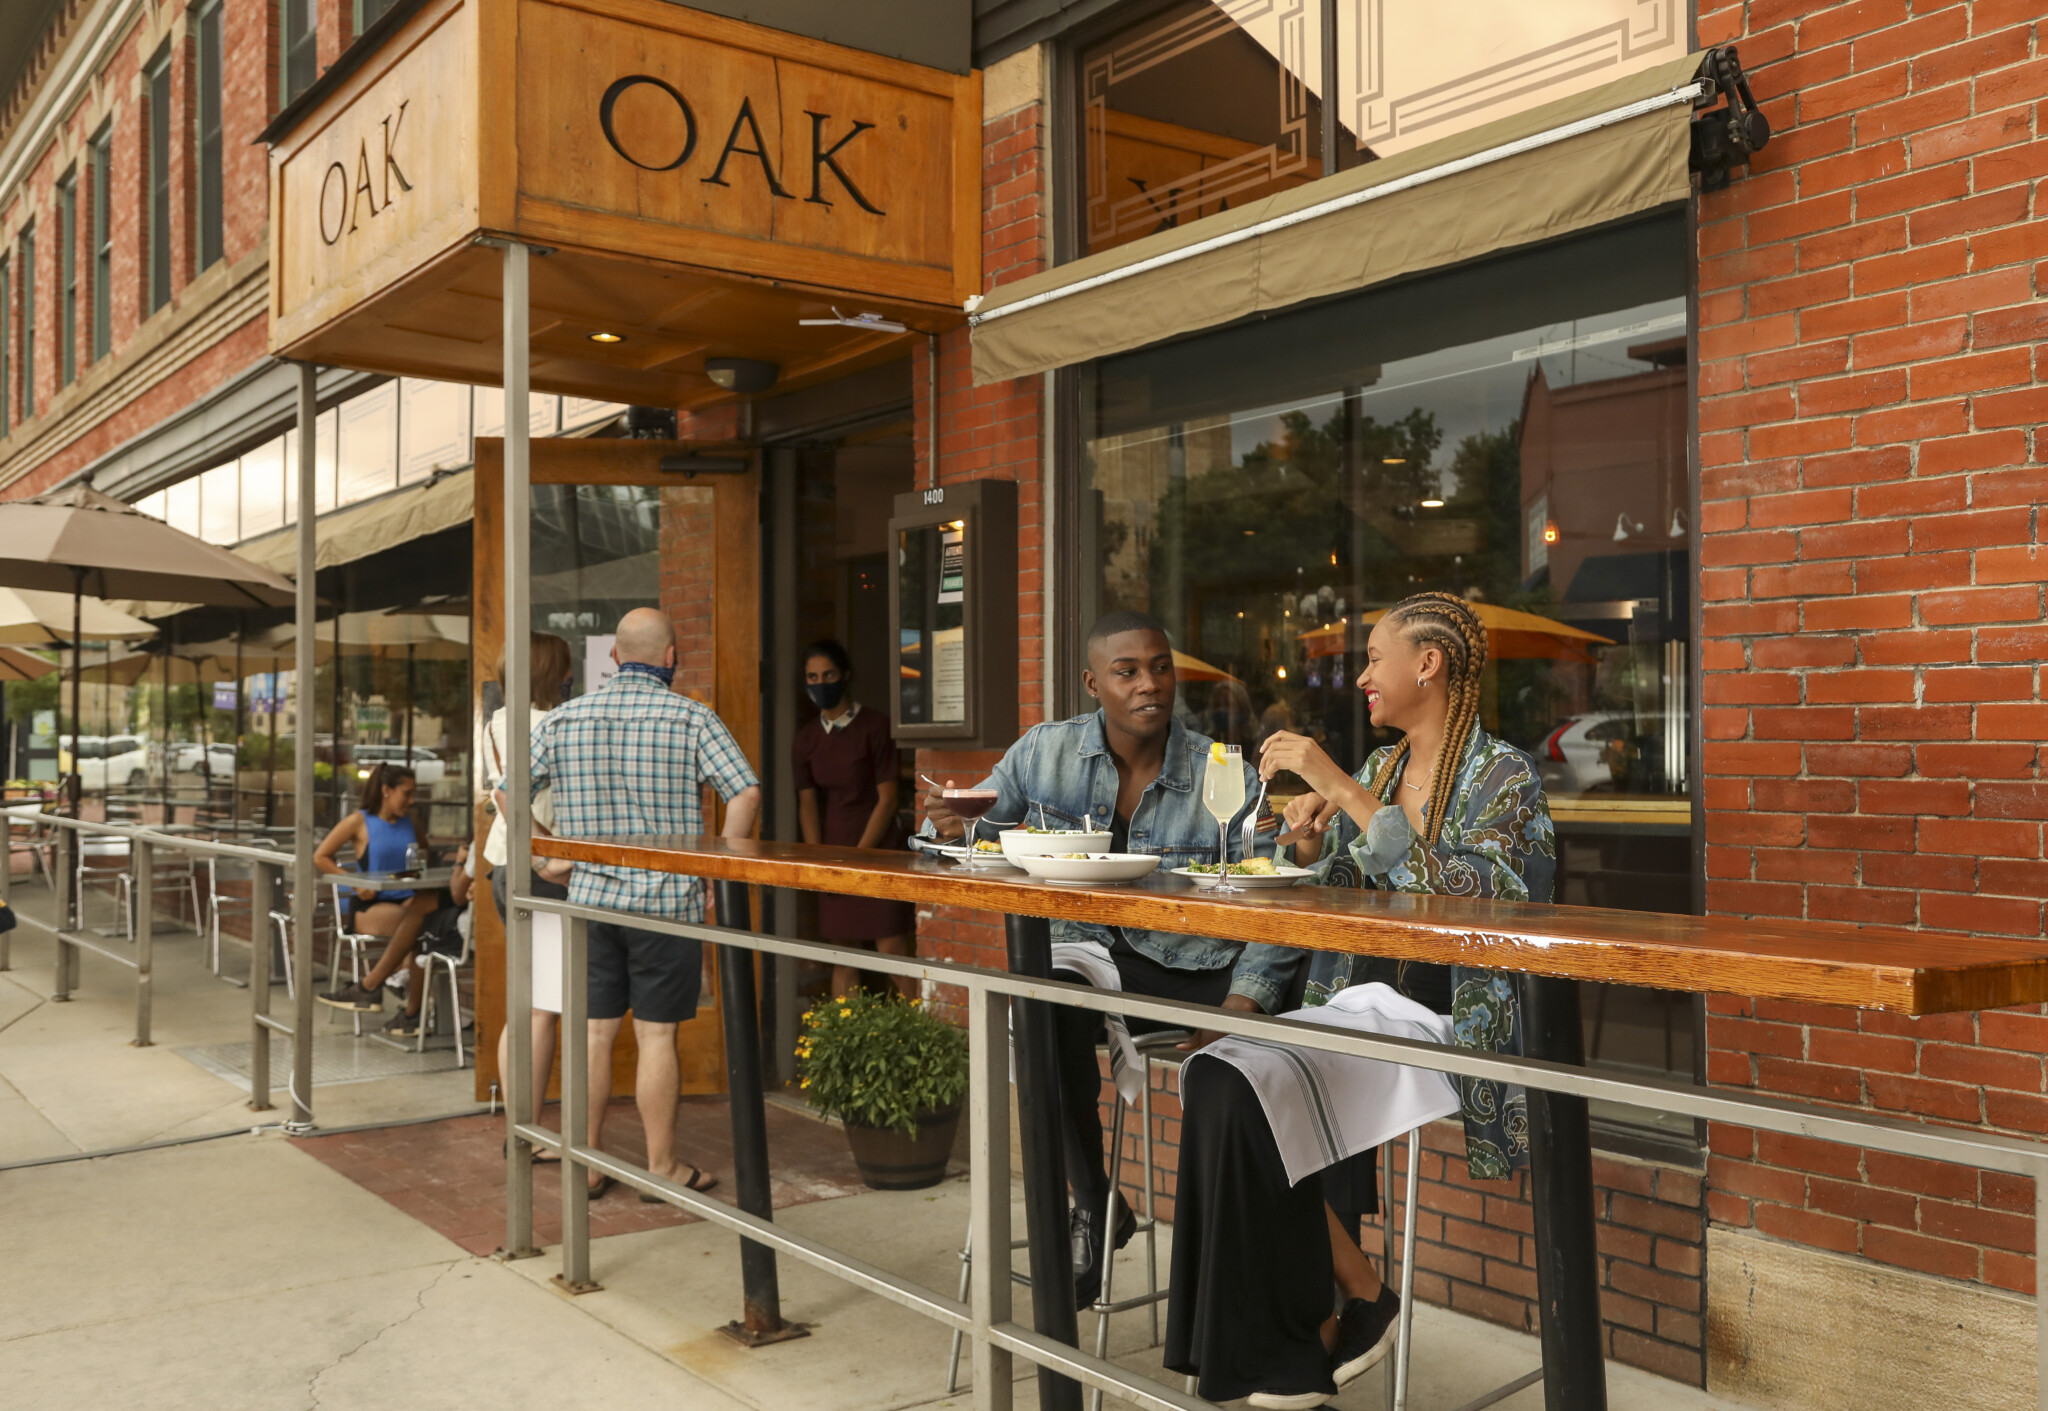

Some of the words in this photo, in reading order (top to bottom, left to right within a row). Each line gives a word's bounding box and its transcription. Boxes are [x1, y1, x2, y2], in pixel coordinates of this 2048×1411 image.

[320, 99, 414, 246] OAK
[600, 74, 886, 217] OAK
[923, 487, 944, 505] 1400
